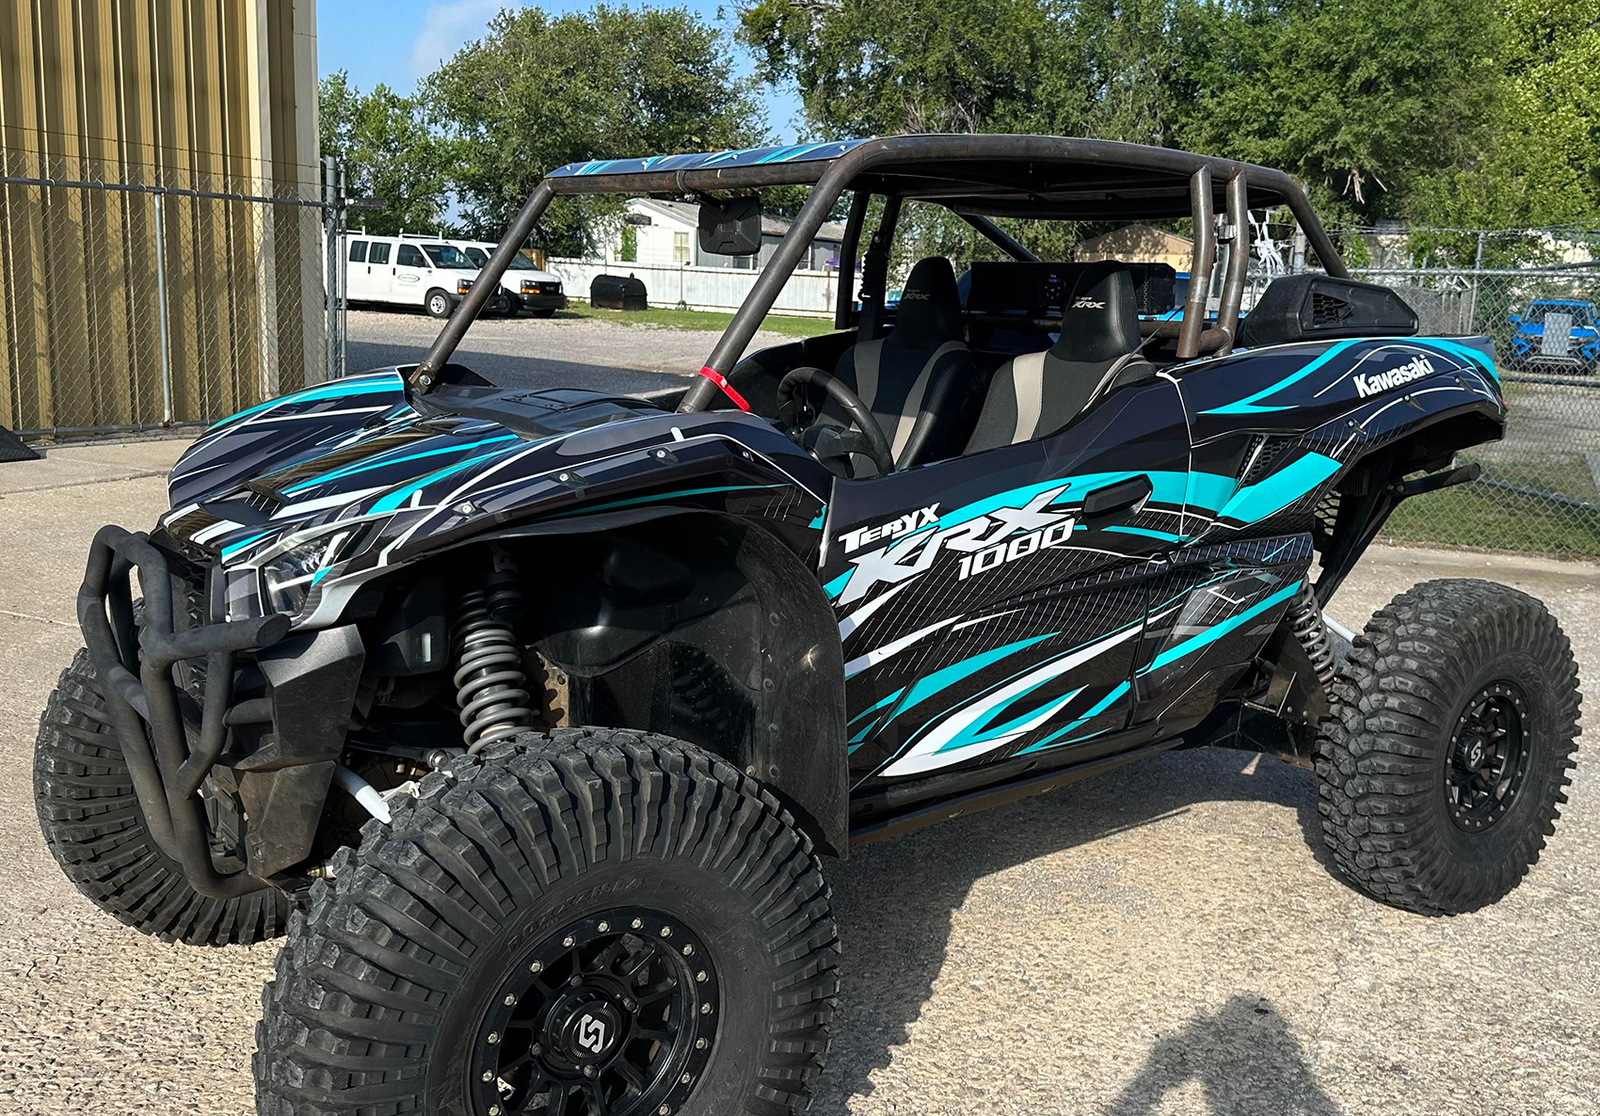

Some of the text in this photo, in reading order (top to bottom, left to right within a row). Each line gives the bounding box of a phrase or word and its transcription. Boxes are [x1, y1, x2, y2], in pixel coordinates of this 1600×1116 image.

[1071, 300, 1106, 309] KRX
[1353, 354, 1435, 399] Kawasaki
[835, 482, 1074, 609] KRX
[838, 502, 942, 554] TERYX
[958, 518, 1077, 582] 1000
